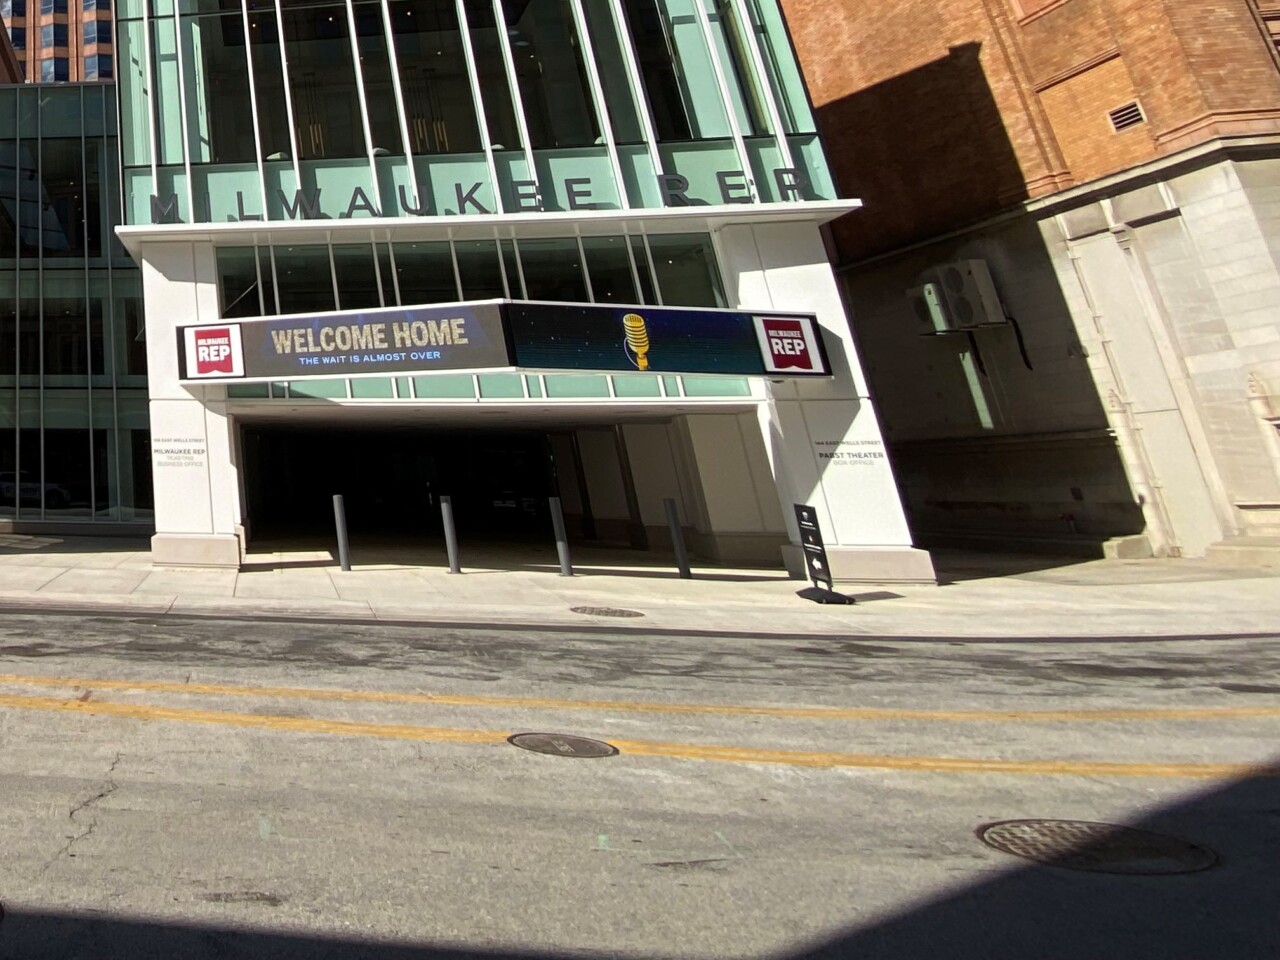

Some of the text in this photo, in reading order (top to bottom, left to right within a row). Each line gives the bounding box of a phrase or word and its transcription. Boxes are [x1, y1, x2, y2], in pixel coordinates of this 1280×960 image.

[149, 168, 808, 223] MILWAUKEE REP
[271, 318, 469, 354] WELCOME HOME
[198, 345, 231, 362] REP
[771, 338, 805, 355] REP
[299, 351, 441, 365] THE WAIT IS ALMOST OVER
